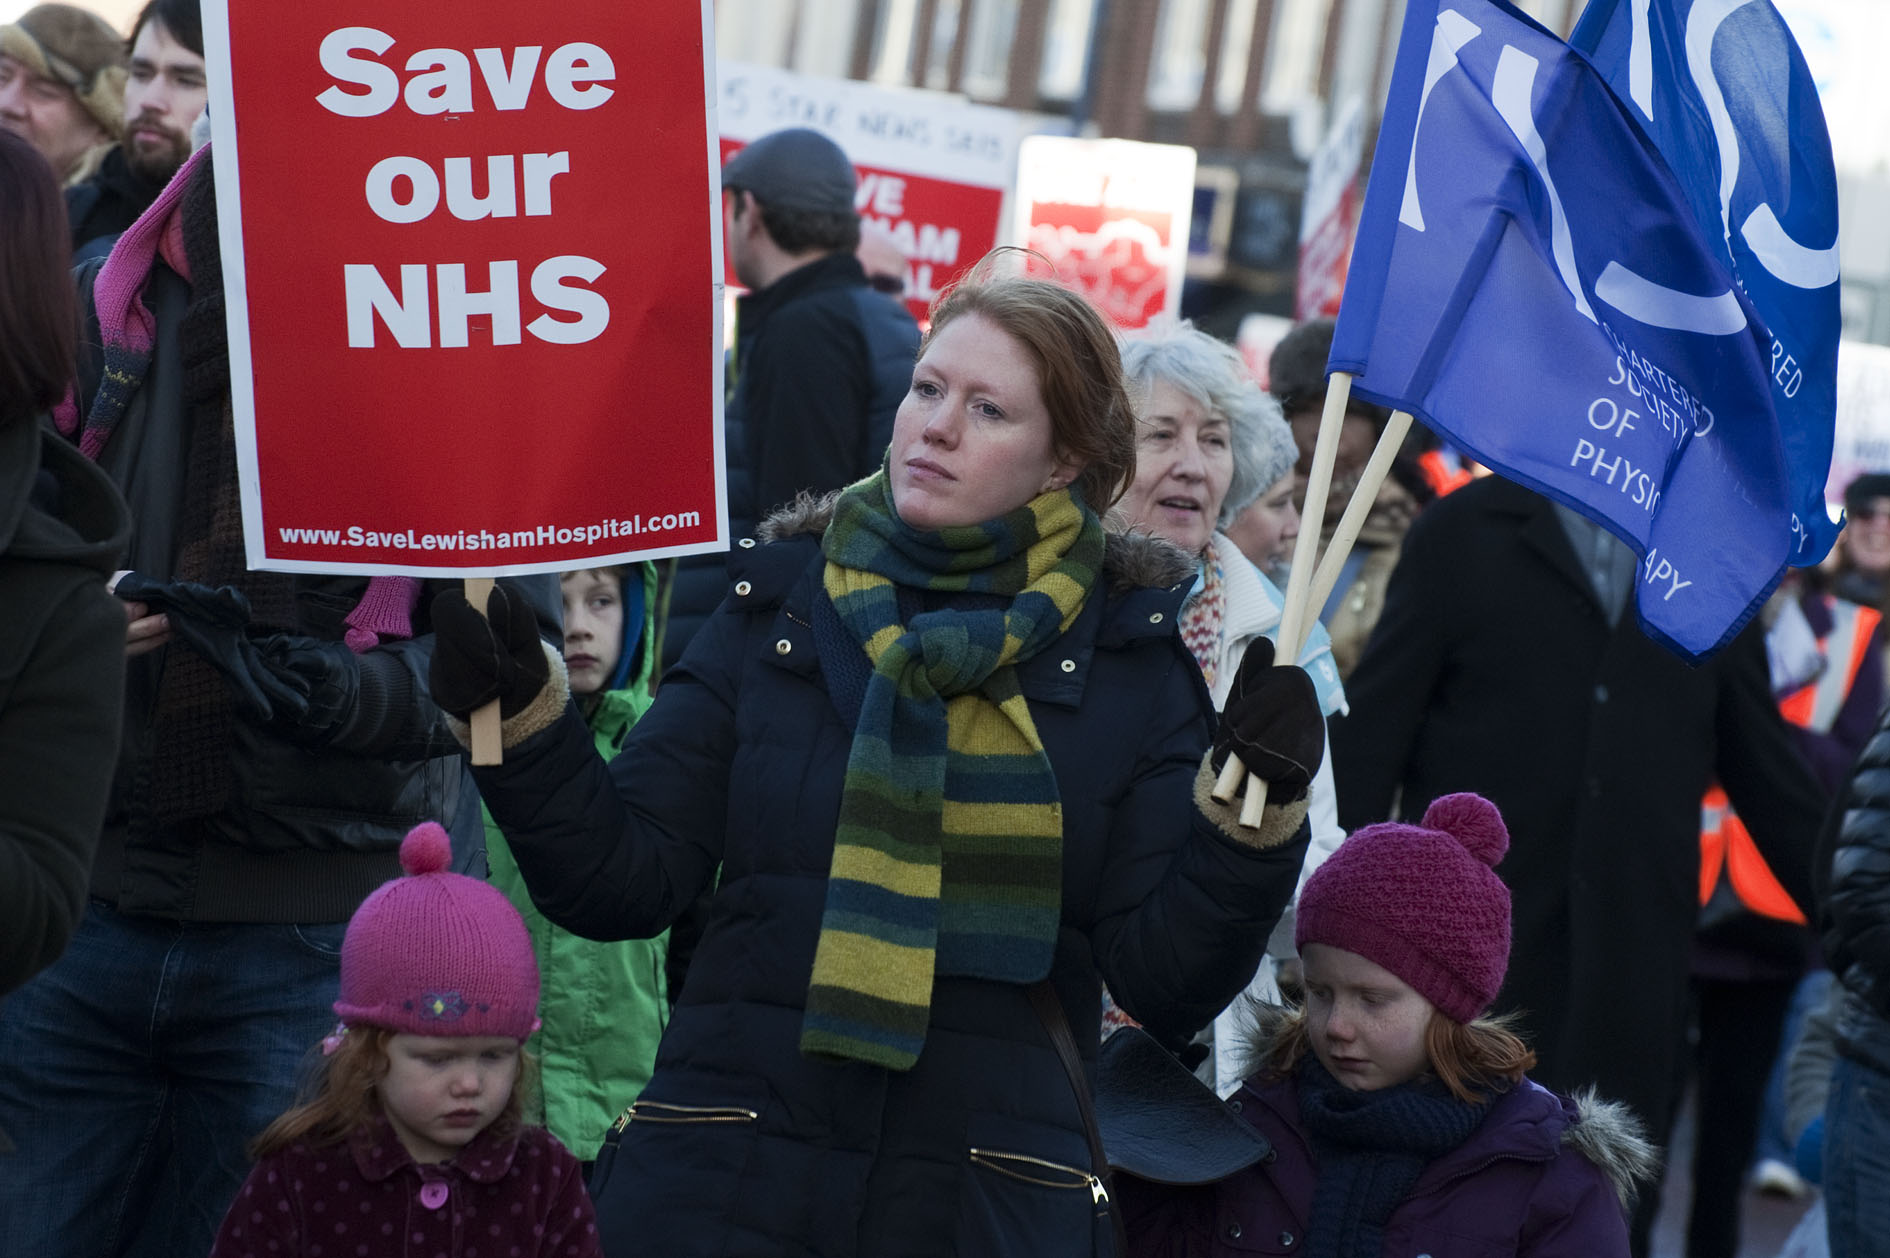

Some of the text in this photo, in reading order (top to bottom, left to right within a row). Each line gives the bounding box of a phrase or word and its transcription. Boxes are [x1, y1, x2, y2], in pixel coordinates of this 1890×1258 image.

[316, 27, 615, 116] Save
[366, 151, 569, 223] our
[854, 173, 906, 217] VE
[344, 256, 609, 348] NHS
[1588, 397, 1640, 438] OF
[1608, 355, 1688, 450] SOCIETY
[279, 511, 701, 550] www.SaveLewishamHospital.com
